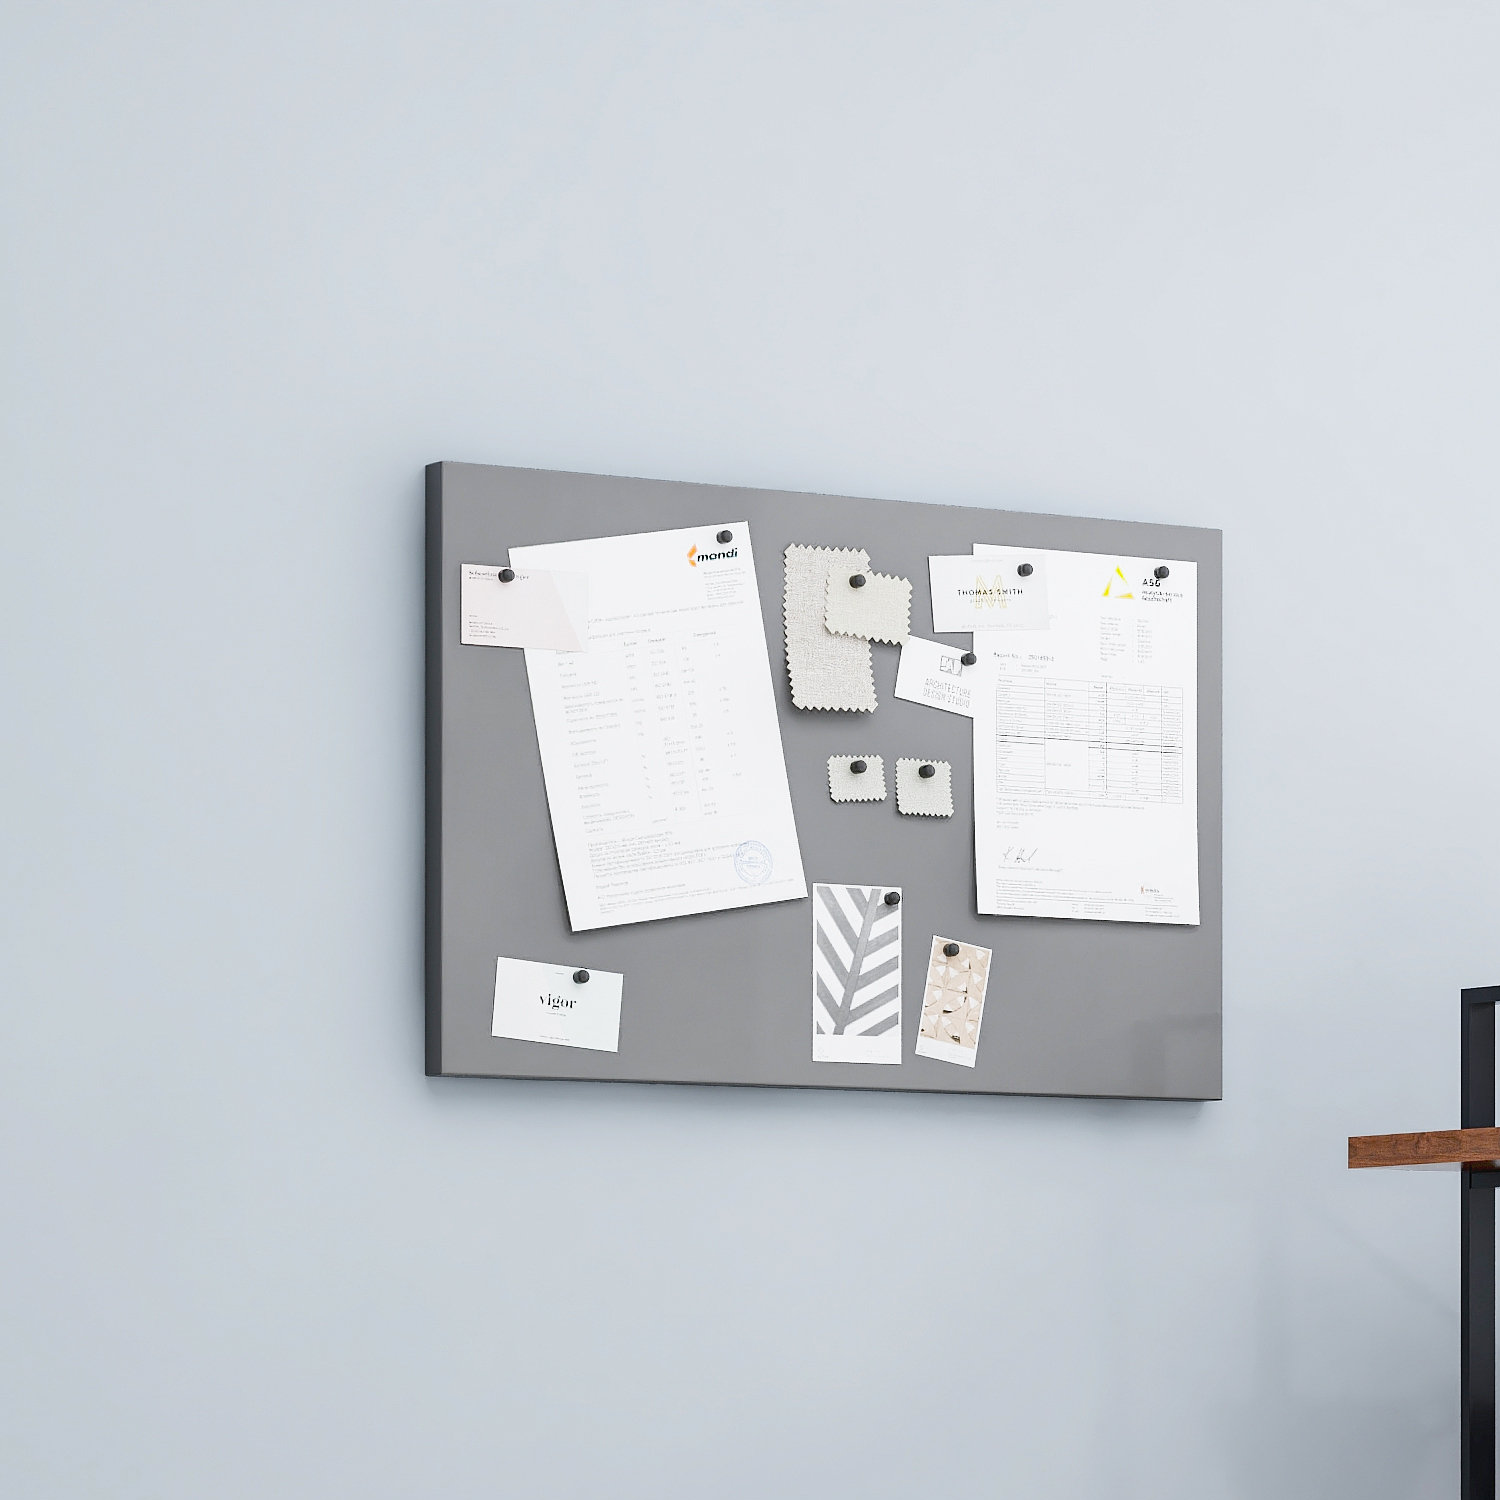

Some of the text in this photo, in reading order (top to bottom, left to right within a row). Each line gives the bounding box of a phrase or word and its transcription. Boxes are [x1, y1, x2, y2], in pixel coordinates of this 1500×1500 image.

[697, 547, 738, 562] mondi
[996, 588, 1024, 596] SMITH
[540, 993, 577, 1010] vigor
